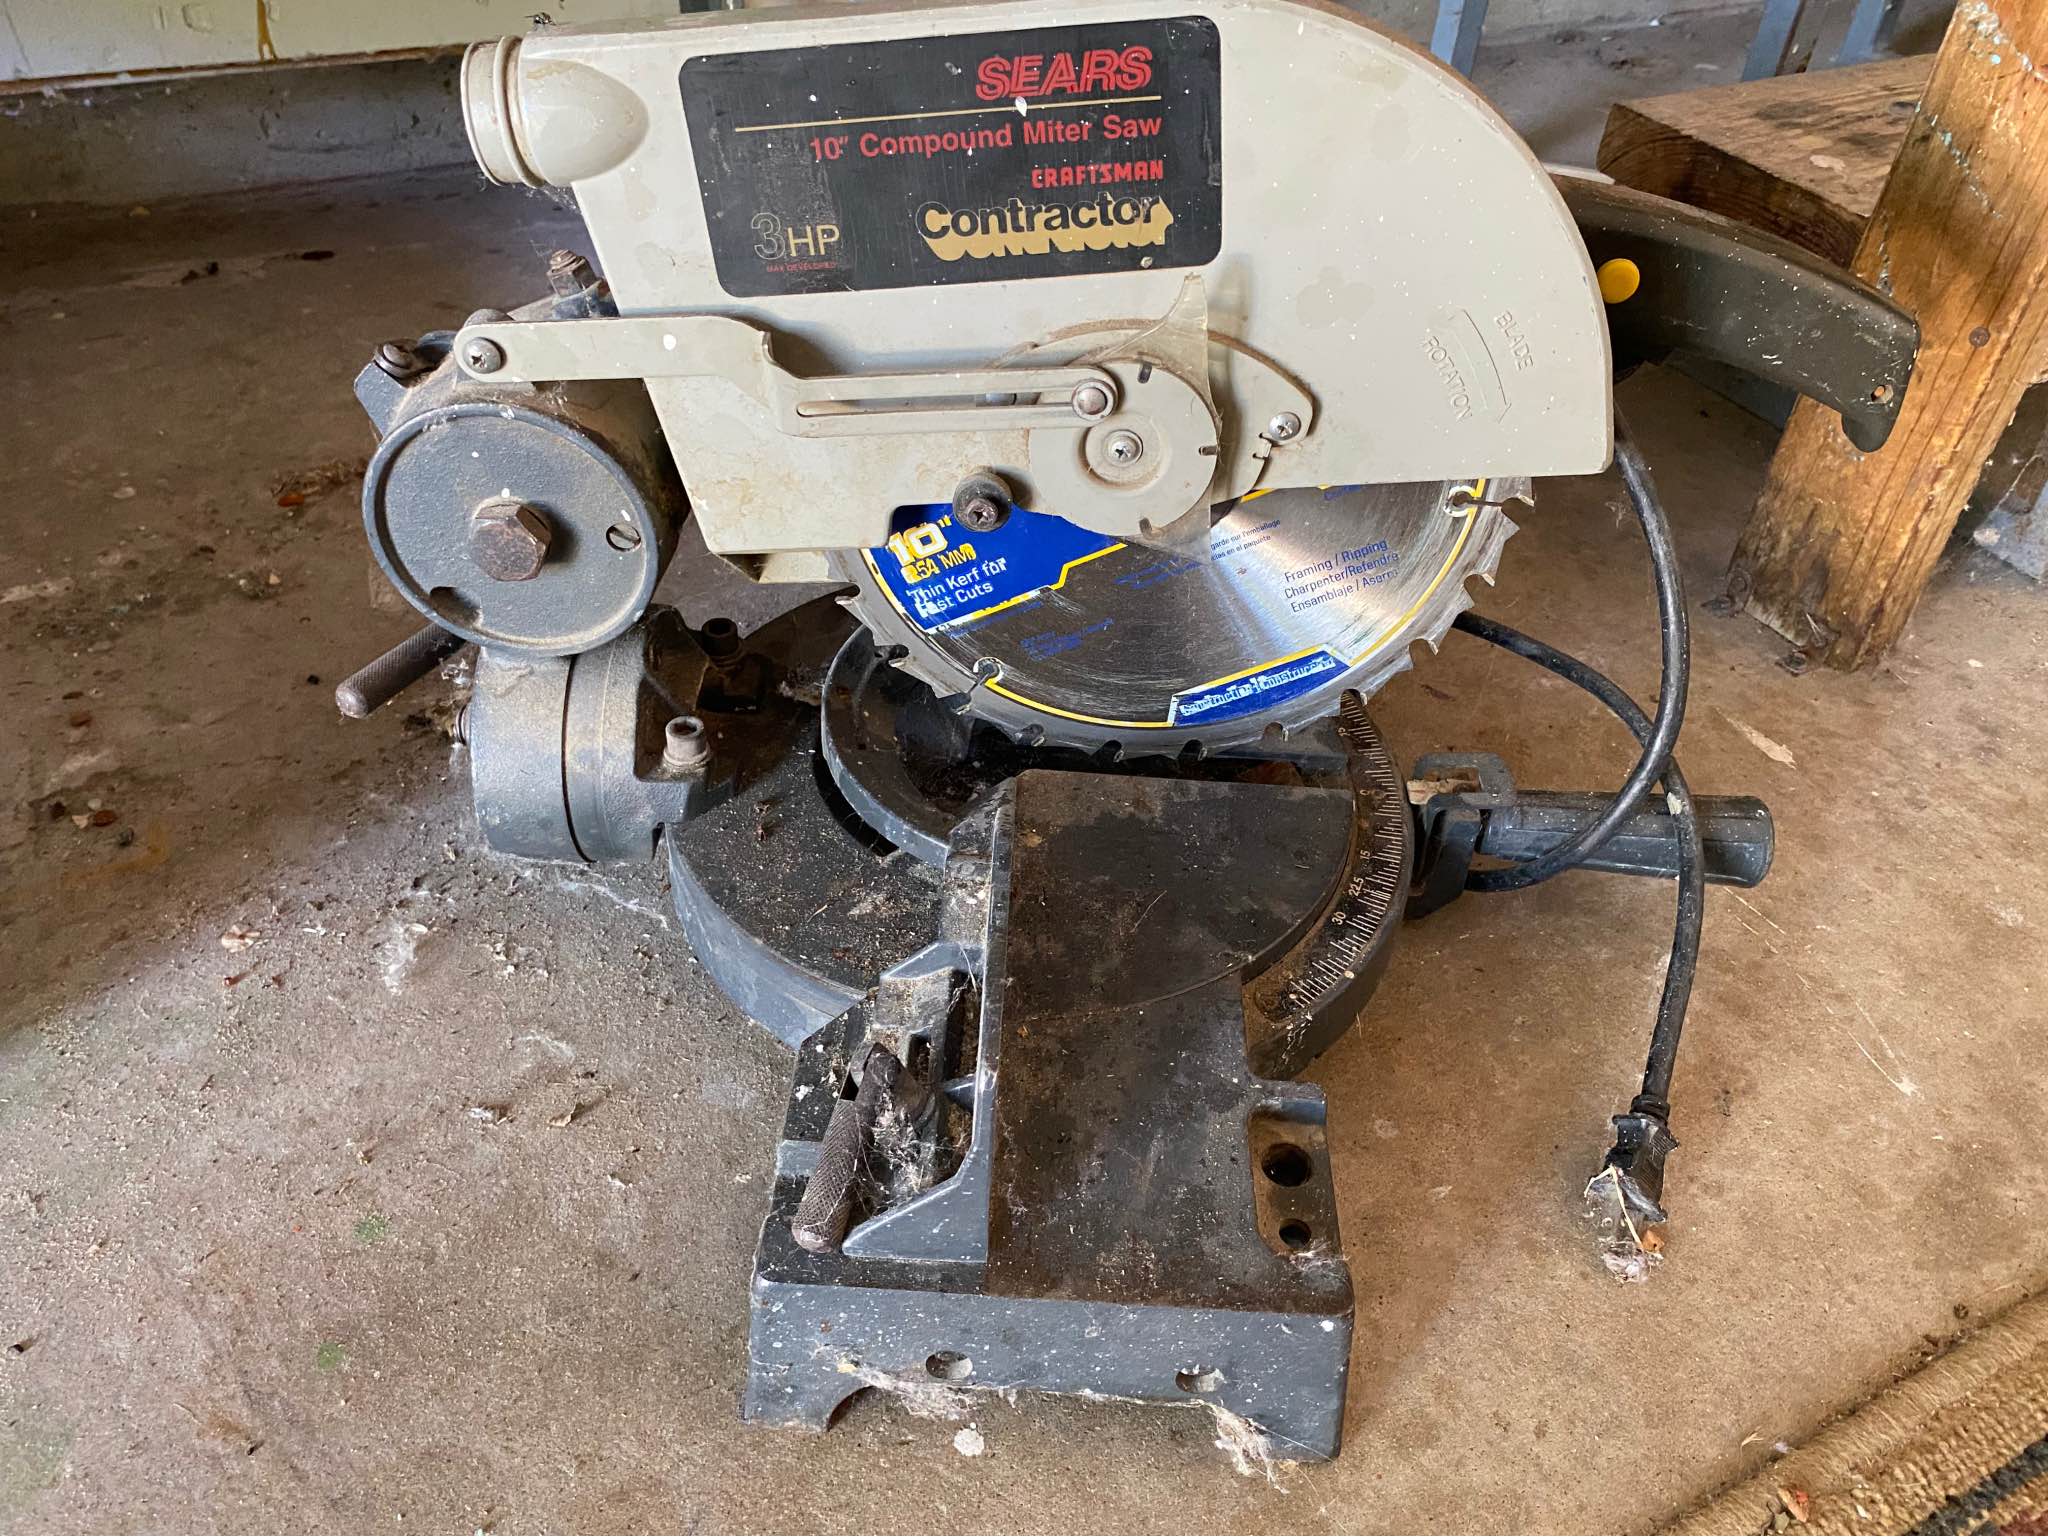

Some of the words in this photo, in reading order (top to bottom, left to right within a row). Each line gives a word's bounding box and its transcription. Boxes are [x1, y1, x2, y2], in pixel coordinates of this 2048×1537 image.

[975, 46, 1153, 101] SEARS
[809, 135, 849, 162] 10"
[860, 122, 1013, 161] Compound
[1023, 117, 1093, 146] Miter
[1103, 115, 1163, 139] Saw
[1031, 160, 1165, 190] CRAFTSMAN
[915, 192, 1173, 252] Contractor
[1495, 311, 1534, 371] BLADE
[1422, 335, 1473, 423] ROTATION
[886, 515, 952, 567] 10"
[1284, 559, 1334, 583] Framing
[1341, 539, 1389, 563] Ripping
[905, 583, 946, 604] Thin
[945, 567, 981, 590] Kerf
[981, 557, 1007, 578] for
[954, 581, 994, 604] Cuts
[1290, 584, 1355, 613] Ensamblaje
[1361, 567, 1400, 588] Aserr
[1360, 849, 1371, 860] 15
[1331, 911, 1347, 925] 30
